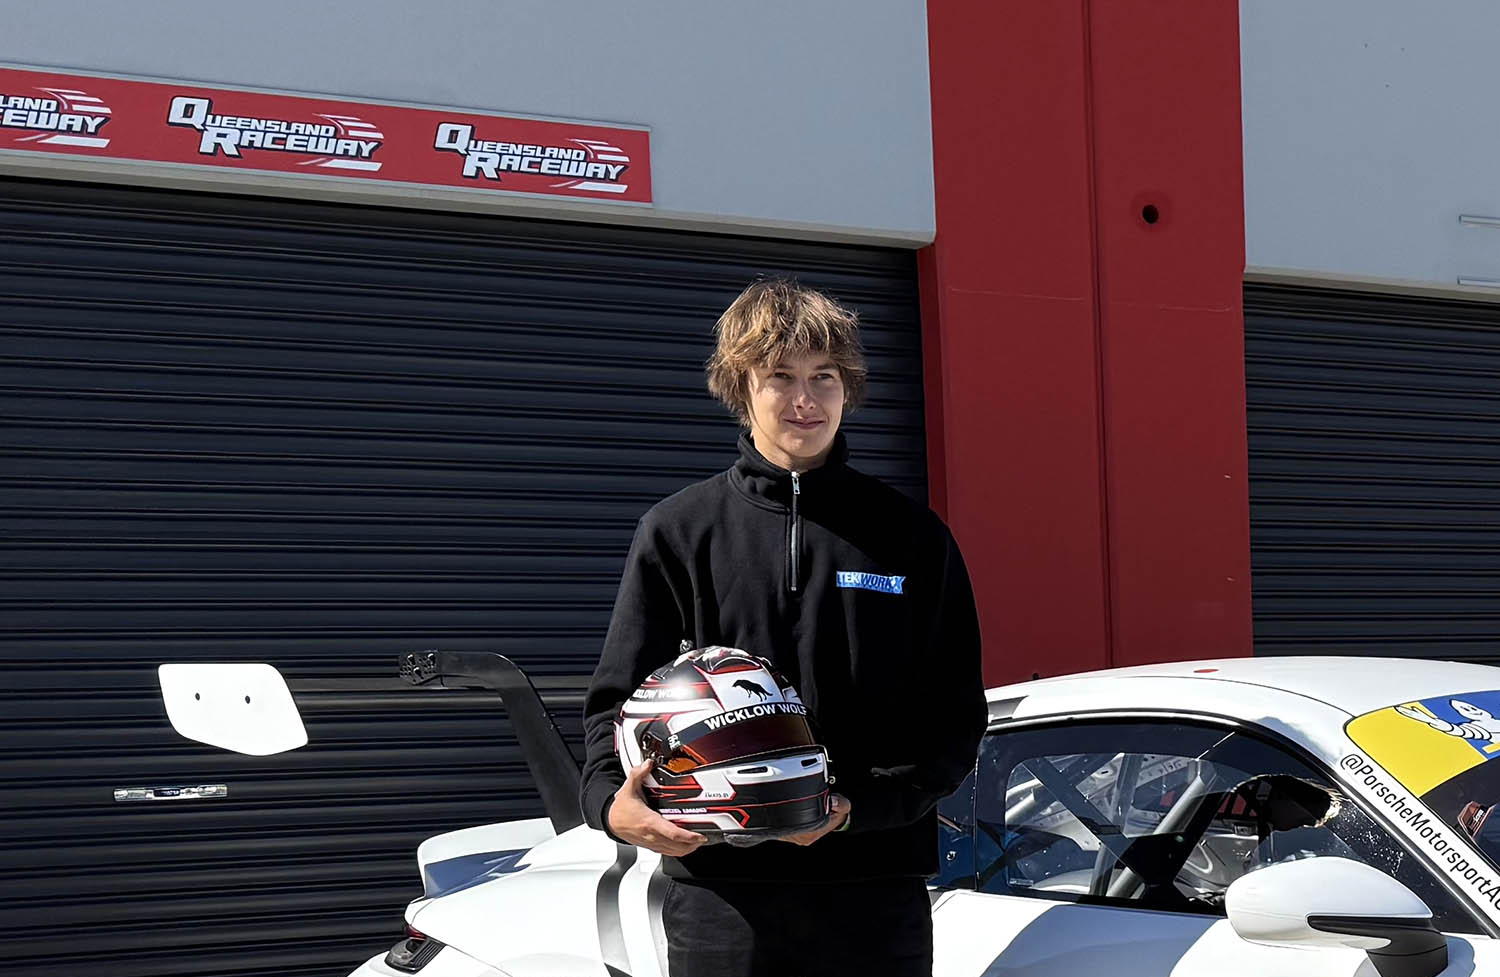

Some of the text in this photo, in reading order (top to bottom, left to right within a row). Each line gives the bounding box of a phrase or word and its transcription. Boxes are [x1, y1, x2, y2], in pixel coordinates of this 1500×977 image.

[0, 108, 106, 133] EWAY
[168, 96, 336, 137] QUEENSLAND
[199, 127, 380, 157] RACEWAY
[434, 122, 586, 161] QUEENSLAND
[462, 151, 625, 180] RACEWAY
[703, 703, 776, 731] WICKLOW
